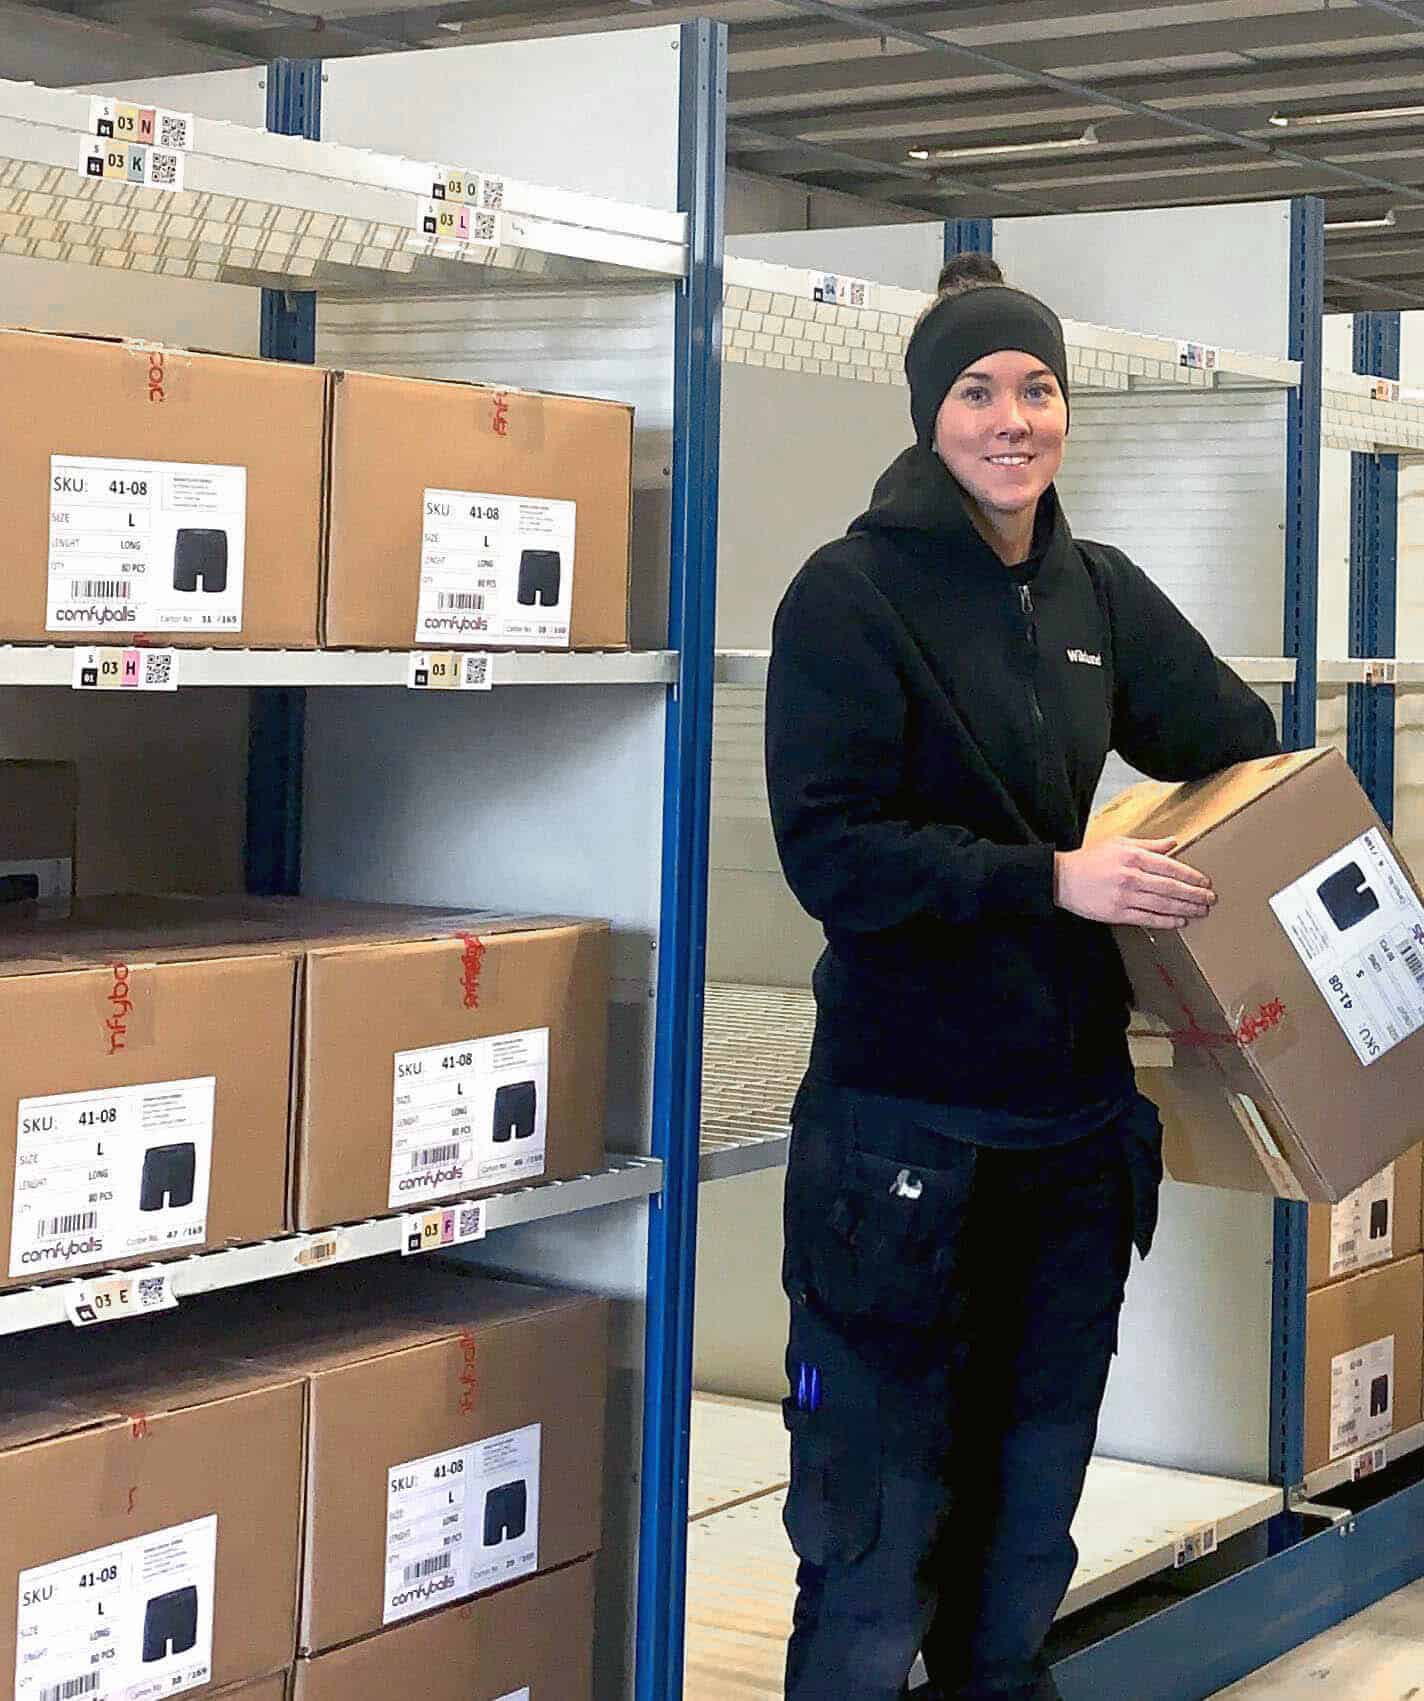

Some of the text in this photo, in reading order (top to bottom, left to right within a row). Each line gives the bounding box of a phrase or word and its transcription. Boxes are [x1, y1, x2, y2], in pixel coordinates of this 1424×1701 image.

[118, 117, 151, 134] 03 N
[108, 153, 142, 171] 03 K
[449, 181, 461, 193] 03
[440, 214, 466, 228] 03 L
[109, 480, 147, 495] 41-08
[128, 513, 135, 527] L
[469, 506, 499, 520] 41-08
[121, 540, 141, 550] LONG
[484, 536, 490, 547] L
[56, 605, 136, 625] comfyballs
[424, 616, 488, 633] comfyballs
[102, 661, 135, 675] 03 H
[433, 664, 445, 676] 03
[1328, 975, 1353, 1010] 41-08
[442, 1053, 473, 1069] 41-08
[457, 1083, 463, 1095] L
[79, 1108, 117, 1125] 41-08
[97, 1142, 104, 1155] L
[399, 1165, 463, 1190] comfyballs
[425, 1220, 451, 1237] 03 F
[21, 1236, 103, 1264] comfyballs
[95, 1290, 128, 1308] 03 E
[434, 1459, 464, 1479] 41-08
[449, 1491, 454, 1504] L
[79, 1565, 117, 1588] 41-08
[392, 1575, 454, 1607] comfyballs
[98, 1602, 104, 1615] L
